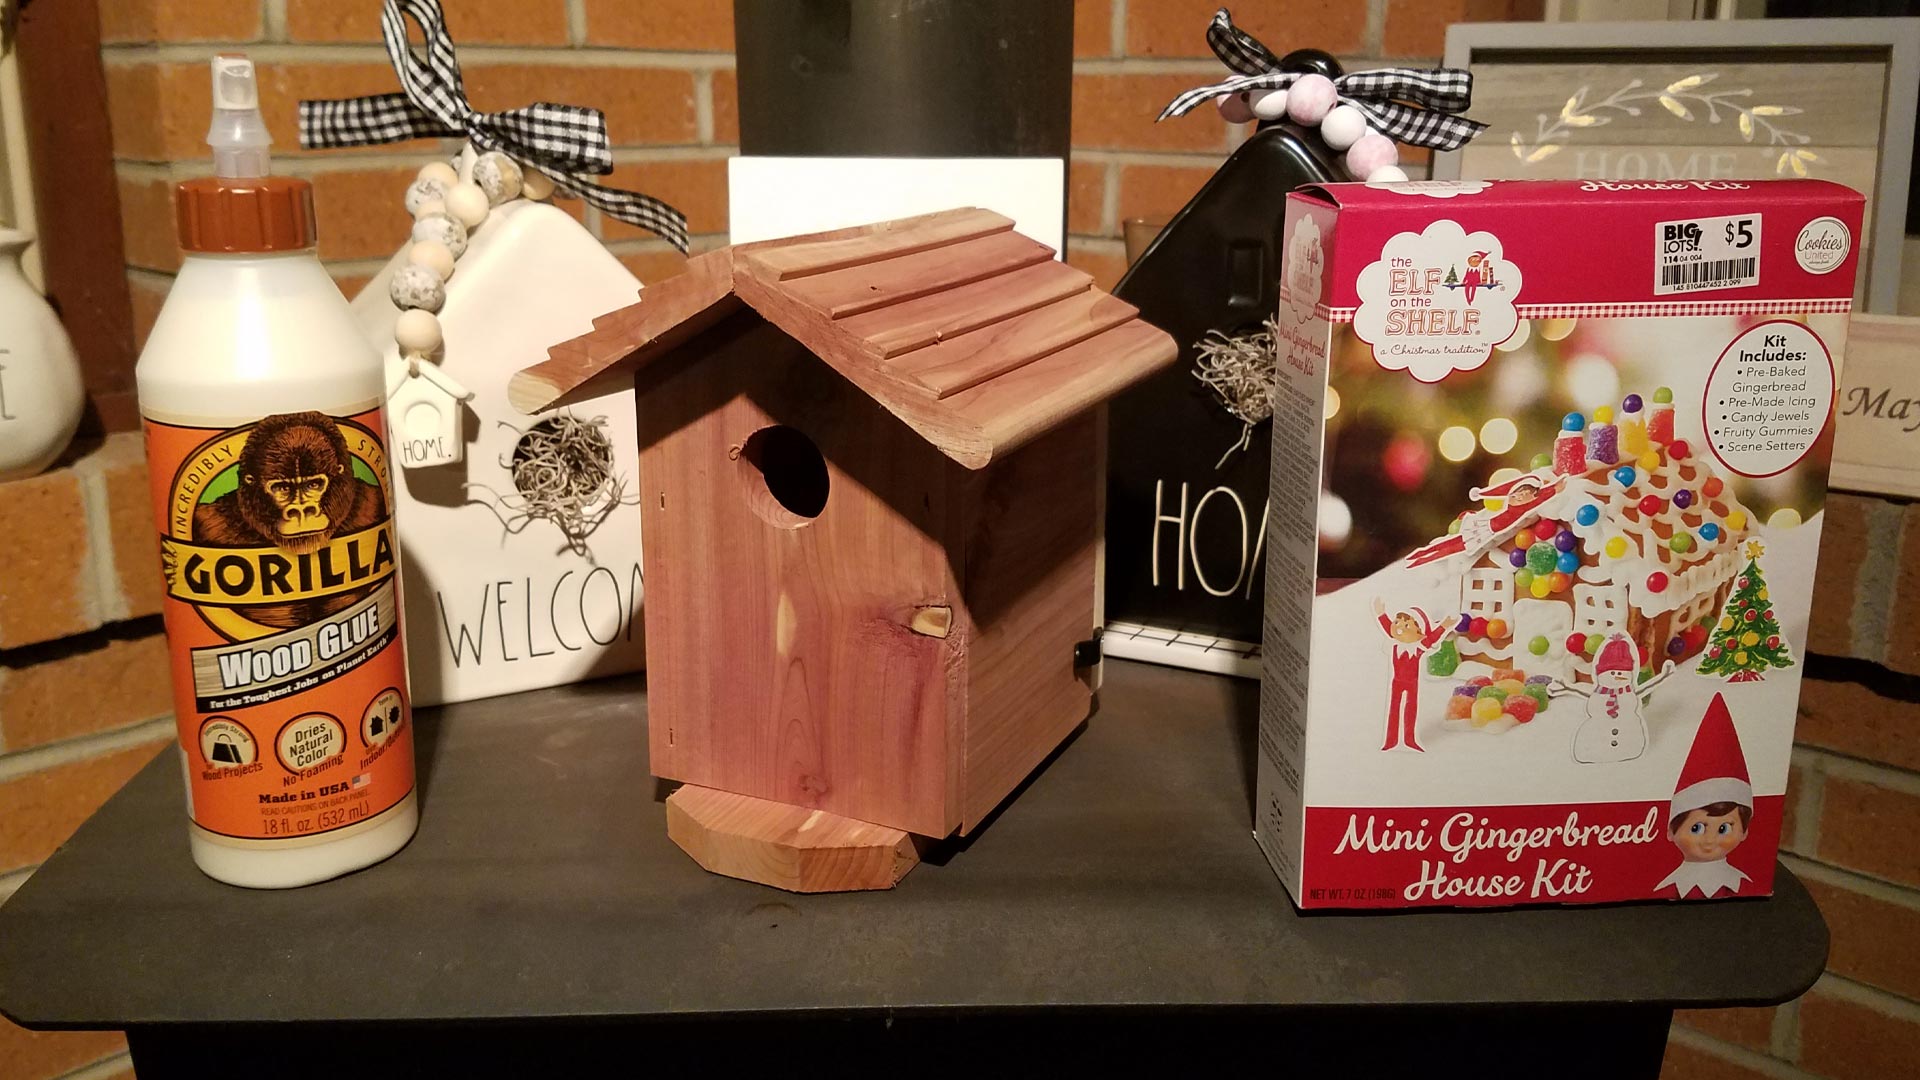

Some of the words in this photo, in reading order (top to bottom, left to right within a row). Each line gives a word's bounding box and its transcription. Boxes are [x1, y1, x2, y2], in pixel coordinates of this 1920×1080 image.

[1664, 223, 1699, 240] BIG
[1725, 220, 1753, 248] $5
[1797, 230, 1842, 251] Cookies
[1391, 257, 1412, 268] the
[1664, 255, 1678, 264] 114
[1805, 251, 1833, 260] United
[1389, 268, 1442, 296] ELF
[1390, 298, 1406, 307] on
[1411, 296, 1432, 307] the
[1385, 309, 1481, 336] SHELF
[1390, 344, 1441, 355] Christmas
[1764, 335, 1787, 347] Kit
[1739, 349, 1807, 362] Includes:
[1746, 366, 1806, 377] Pre-Baked
[1732, 381, 1807, 395] Gingerbread
[1728, 397, 1785, 407] Pre-Made
[1788, 396, 1816, 408] Icing
[1731, 412, 1768, 424] Candy
[1770, 411, 1810, 422] Jewels
[1723, 427, 1756, 439] Fruity
[1758, 426, 1814, 436] Gummies
[1727, 442, 1763, 452] Scene
[1766, 441, 1806, 451] Setters
[176, 445, 234, 535] INCREDIBLY
[358, 439, 389, 492] STRO
[1152, 479, 1270, 600] HO
[184, 528, 394, 596] GORILLA
[210, 700, 225, 709] For
[226, 698, 242, 707] the
[243, 685, 292, 704] Toughest
[293, 676, 319, 691] Jobs
[322, 670, 335, 680] on
[336, 651, 366, 674] Planet
[367, 637, 388, 657] Earth
[295, 723, 326, 743] Dries
[289, 730, 333, 758] Natural
[297, 746, 329, 767] Color
[224, 763, 263, 778] Projects
[283, 776, 296, 787] No
[300, 754, 344, 780] Foaming
[259, 793, 297, 803] Made
[301, 791, 316, 800] in
[319, 781, 349, 797] USA
[261, 807, 279, 815] READ
[281, 802, 317, 815] CAUTIONS
[319, 800, 329, 808] ON
[263, 819, 278, 834] 18
[281, 819, 293, 833] fl.
[297, 819, 314, 832] oz.
[317, 808, 345, 830] (532
[348, 800, 369, 819] mL)
[1333, 814, 1433, 855] Mini
[1439, 806, 1659, 863] Gingerbread
[1403, 860, 1524, 900] House
[1530, 859, 1593, 899] Kit
[1310, 889, 1325, 899] NET
[1329, 889, 1345, 900] WT.
[1346, 889, 1351, 899] 7
[1354, 888, 1366, 900] OZ
